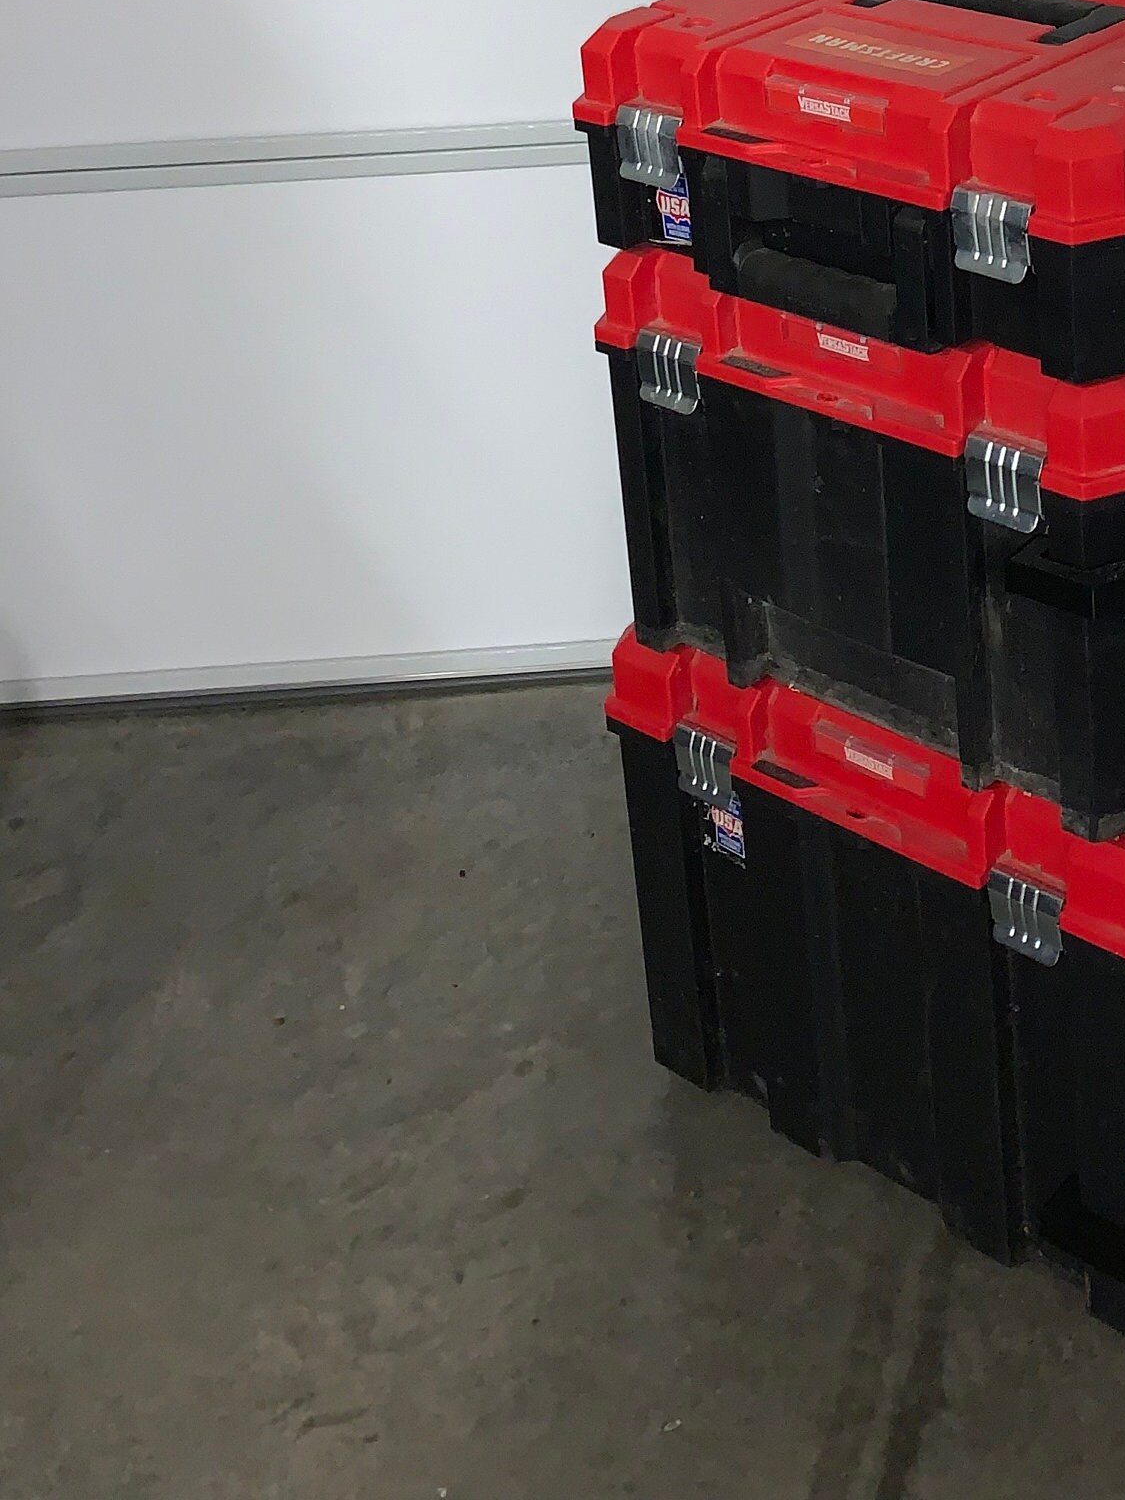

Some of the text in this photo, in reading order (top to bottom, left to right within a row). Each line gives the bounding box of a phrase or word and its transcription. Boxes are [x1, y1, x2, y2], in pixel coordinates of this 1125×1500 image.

[808, 33, 950, 69] CRAFTSMAN
[660, 195, 690, 218] USA
[711, 805, 743, 836] USA
